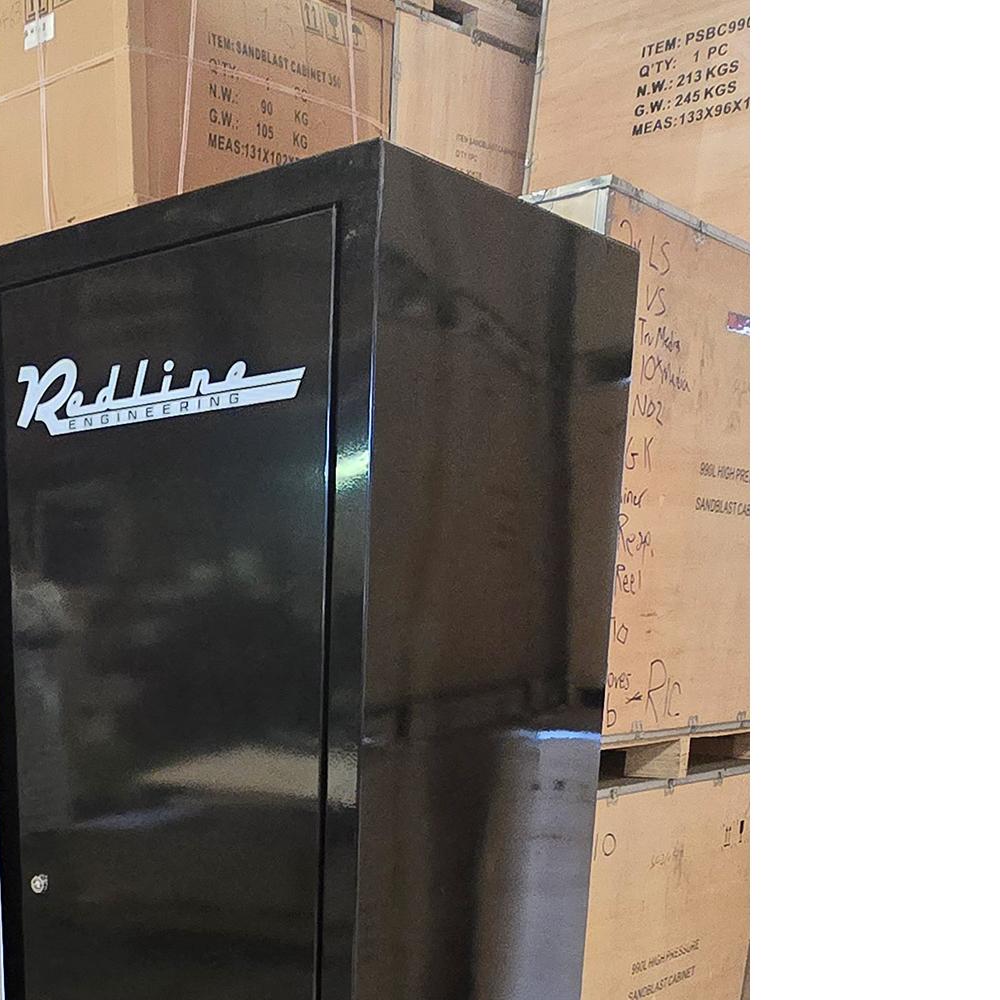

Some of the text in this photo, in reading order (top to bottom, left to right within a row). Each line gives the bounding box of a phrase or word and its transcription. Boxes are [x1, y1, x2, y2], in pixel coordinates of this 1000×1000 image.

[236, 41, 289, 71] SANDBLAST
[290, 61, 327, 83] CABINET
[639, 43, 729, 78] Q'TY: 1 PC
[641, 36, 681, 58] ITEM:
[636, 60, 740, 98] N.W.: 213 KGS
[208, 83, 309, 127] N.W.: 90 KG
[634, 80, 737, 117] G.W.: 245 KGS
[208, 108, 308, 149] G.W.: 105 KG
[648, 235, 670, 276] LS
[646, 284, 666, 316] VS
[16, 357, 306, 430] Redline
[67, 392, 240, 430] ENGINEERING
[695, 496, 737, 515] SANDBLAST
[668, 965, 696, 986] CABINET
